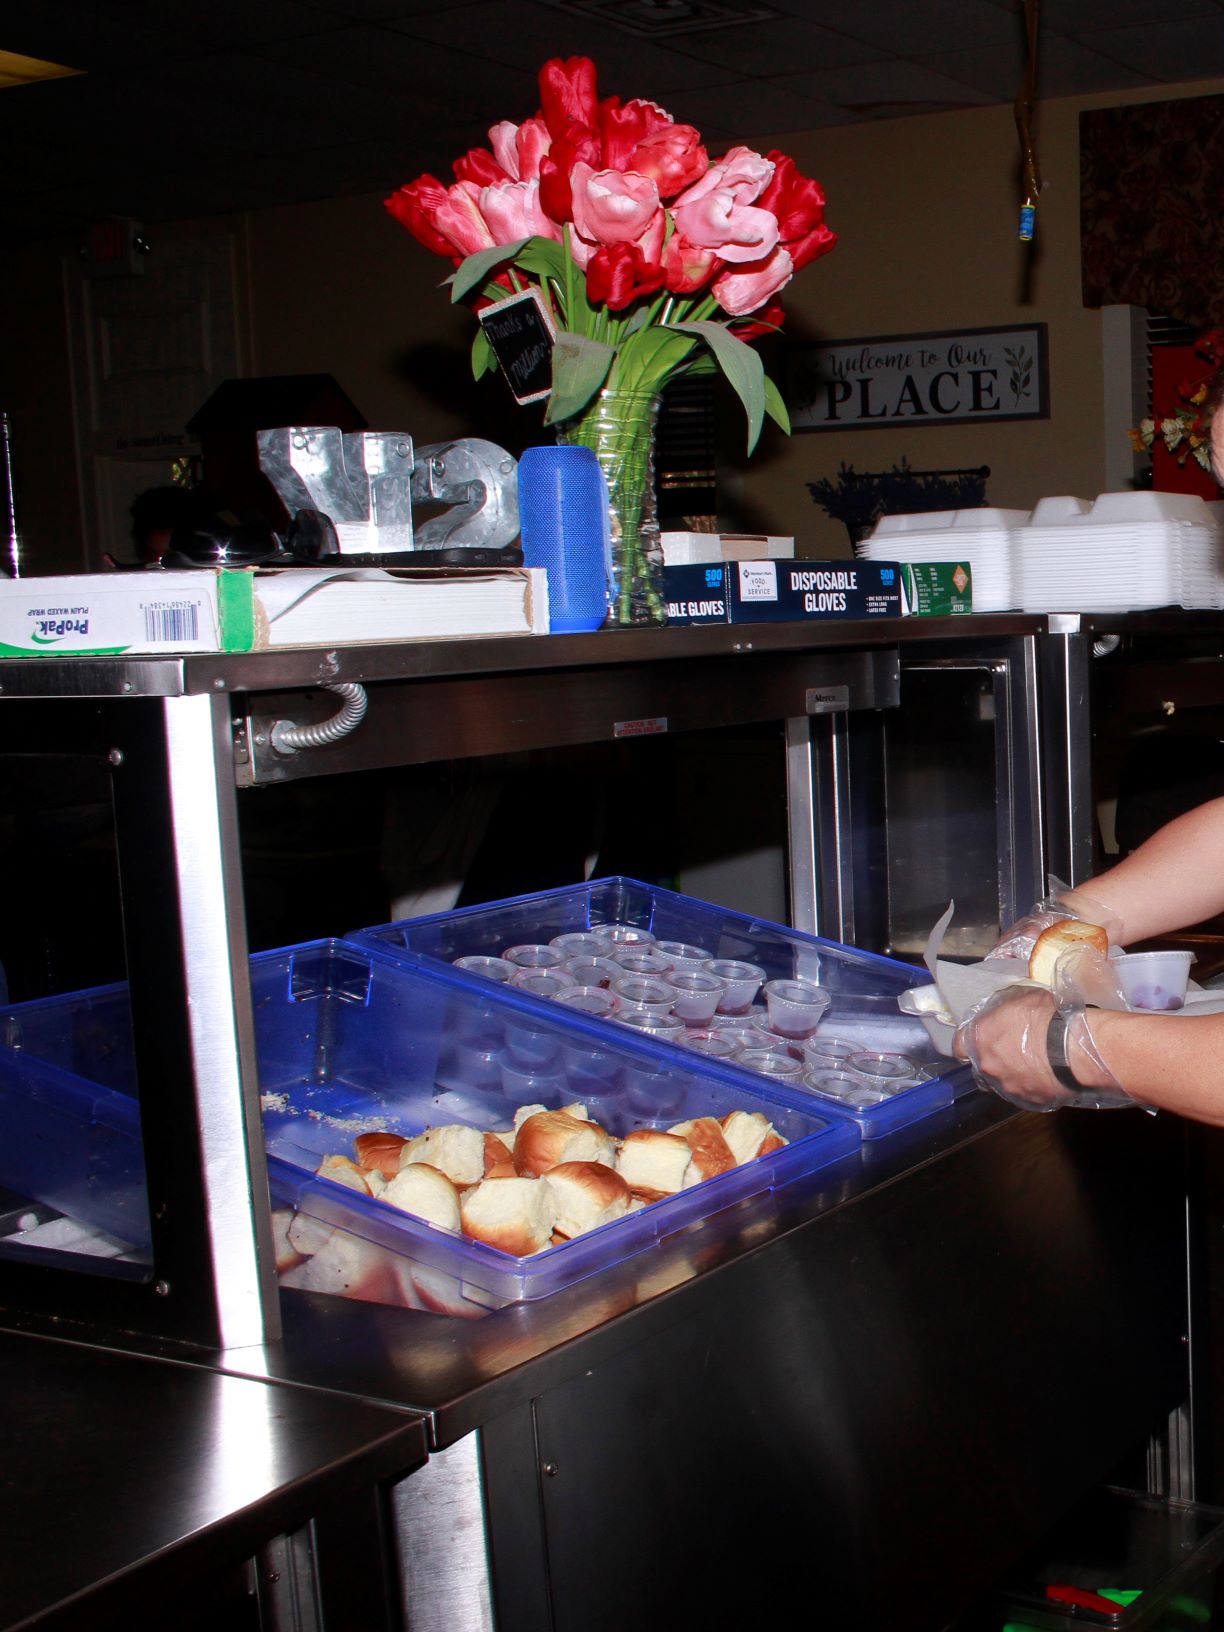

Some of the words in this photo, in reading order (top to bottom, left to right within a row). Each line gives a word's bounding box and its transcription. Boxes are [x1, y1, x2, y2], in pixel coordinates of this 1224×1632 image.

[828, 346, 914, 379] Welcome
[919, 349, 941, 369] to
[946, 342, 993, 369] Our
[824, 368, 1001, 421] PLACE
[704, 568, 723, 582] 500
[790, 571, 858, 591] DISPOSABLE
[880, 568, 895, 580] 500
[687, 600, 725, 617] GLOVES
[804, 592, 847, 613] GLOVES
[27, 608, 46, 617] WRAP
[47, 607, 70, 616] WAXED
[70, 606, 89, 615] PLAIN
